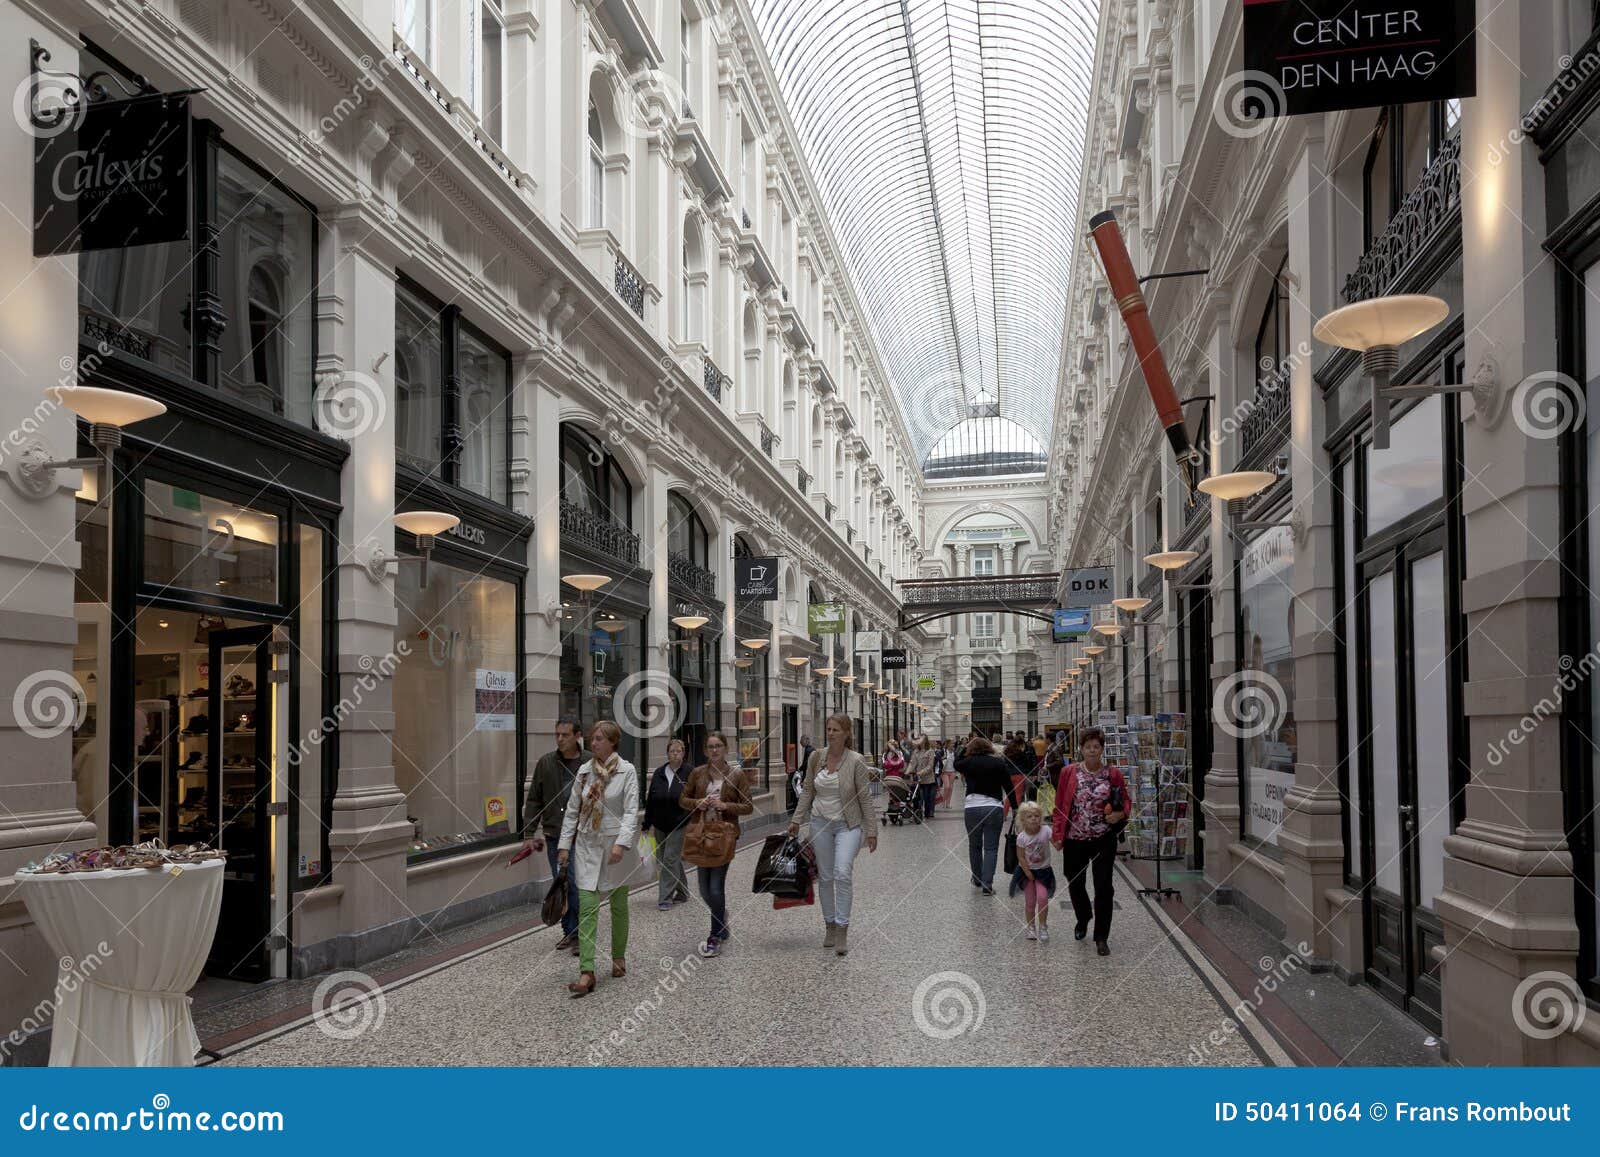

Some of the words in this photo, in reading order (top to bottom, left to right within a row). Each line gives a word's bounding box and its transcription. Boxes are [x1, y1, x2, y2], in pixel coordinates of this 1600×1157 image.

[1293, 9, 1422, 45] CENTER
[1281, 60, 1340, 90] DEN
[1351, 51, 1437, 83] HAAG
[52, 150, 164, 202] Calexis
[1071, 578, 1109, 592] DOK
